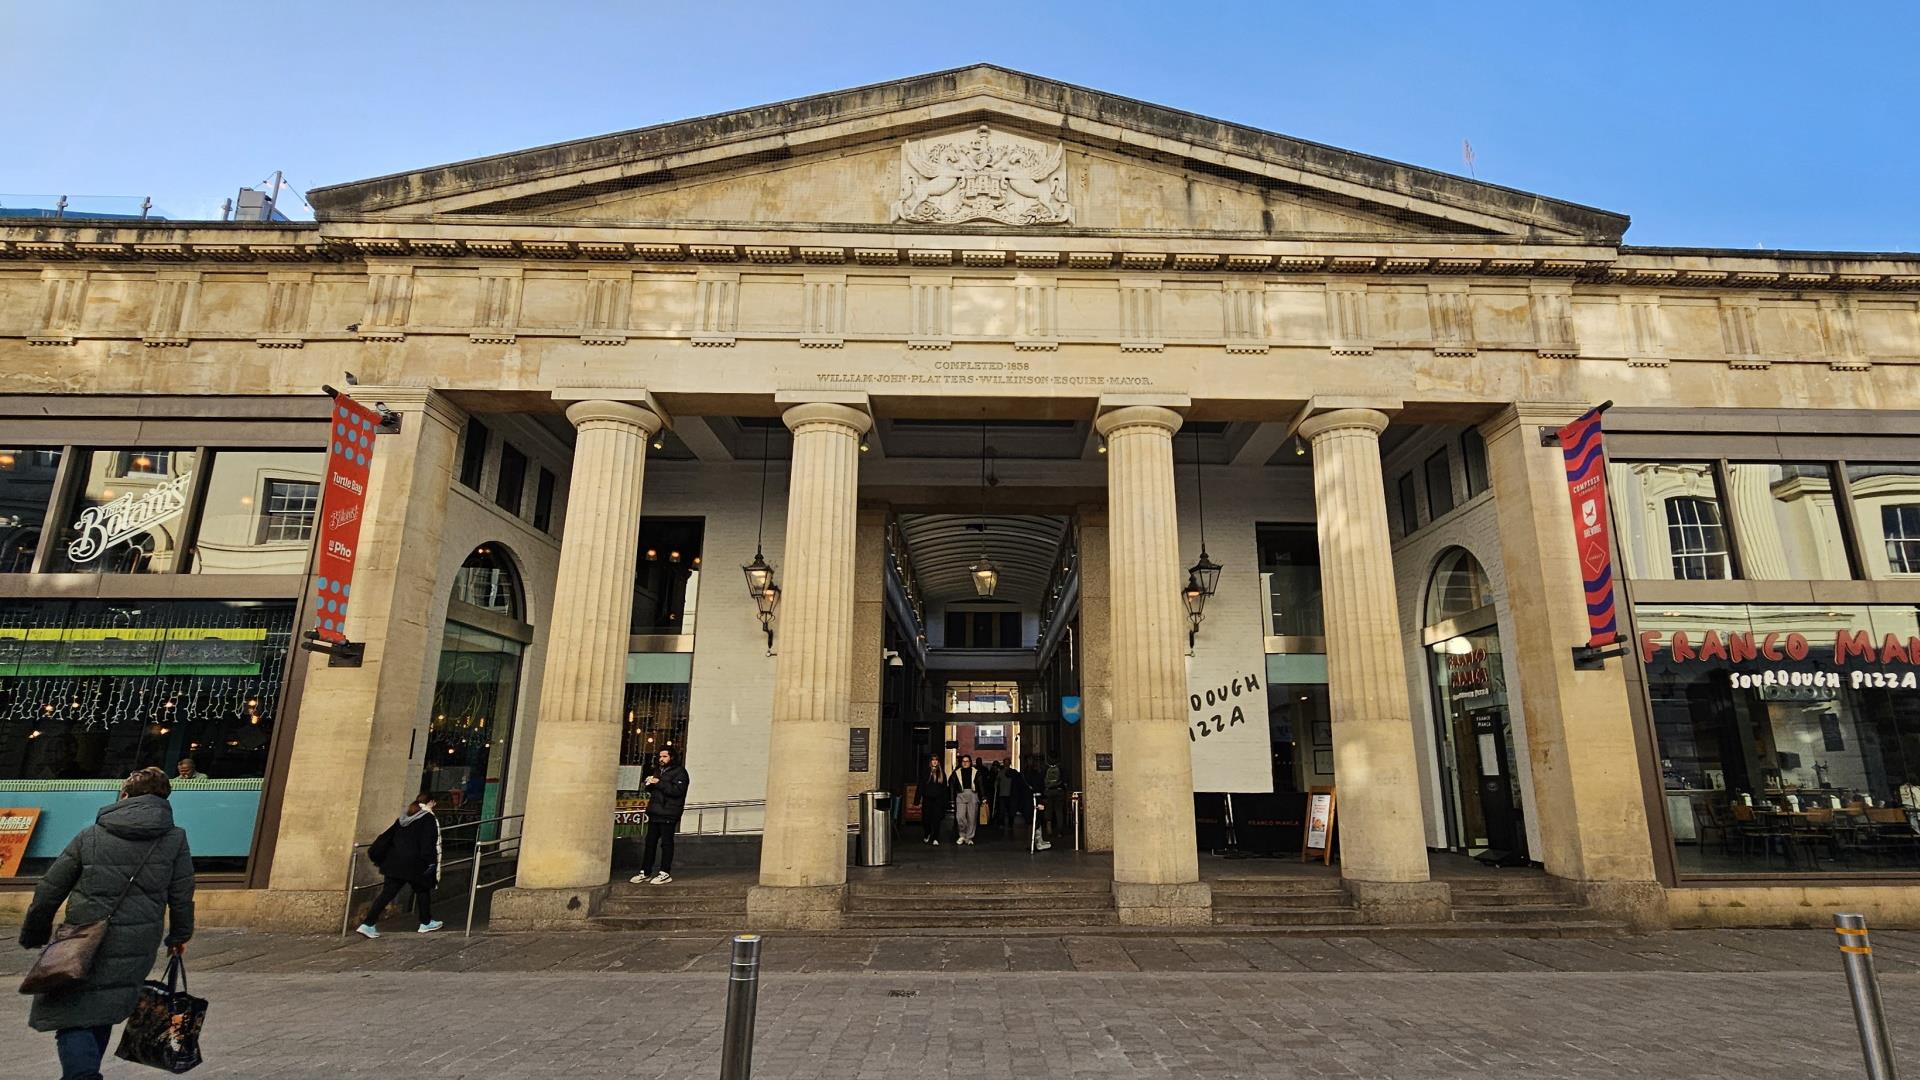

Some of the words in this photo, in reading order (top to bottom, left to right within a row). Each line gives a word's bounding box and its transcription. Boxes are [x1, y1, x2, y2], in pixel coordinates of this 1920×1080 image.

[934, 361, 1004, 370] COMPLETED
[816, 374, 874, 383] WILLIAM
[876, 374, 908, 383] JOHN
[979, 375, 1049, 385] WILKINSON
[1053, 376, 1105, 386] ESQUIRE
[333, 471, 352, 489] Turtle
[351, 480, 363, 496] Bay
[68, 470, 192, 563] Botanis
[334, 540, 352, 558] Pho
[1640, 629, 1809, 664] FRANCO
[1729, 669, 1841, 689] SOURDOUGH
[1850, 671, 1918, 690] PIZZA
[1190, 673, 1260, 712] DOUGH
